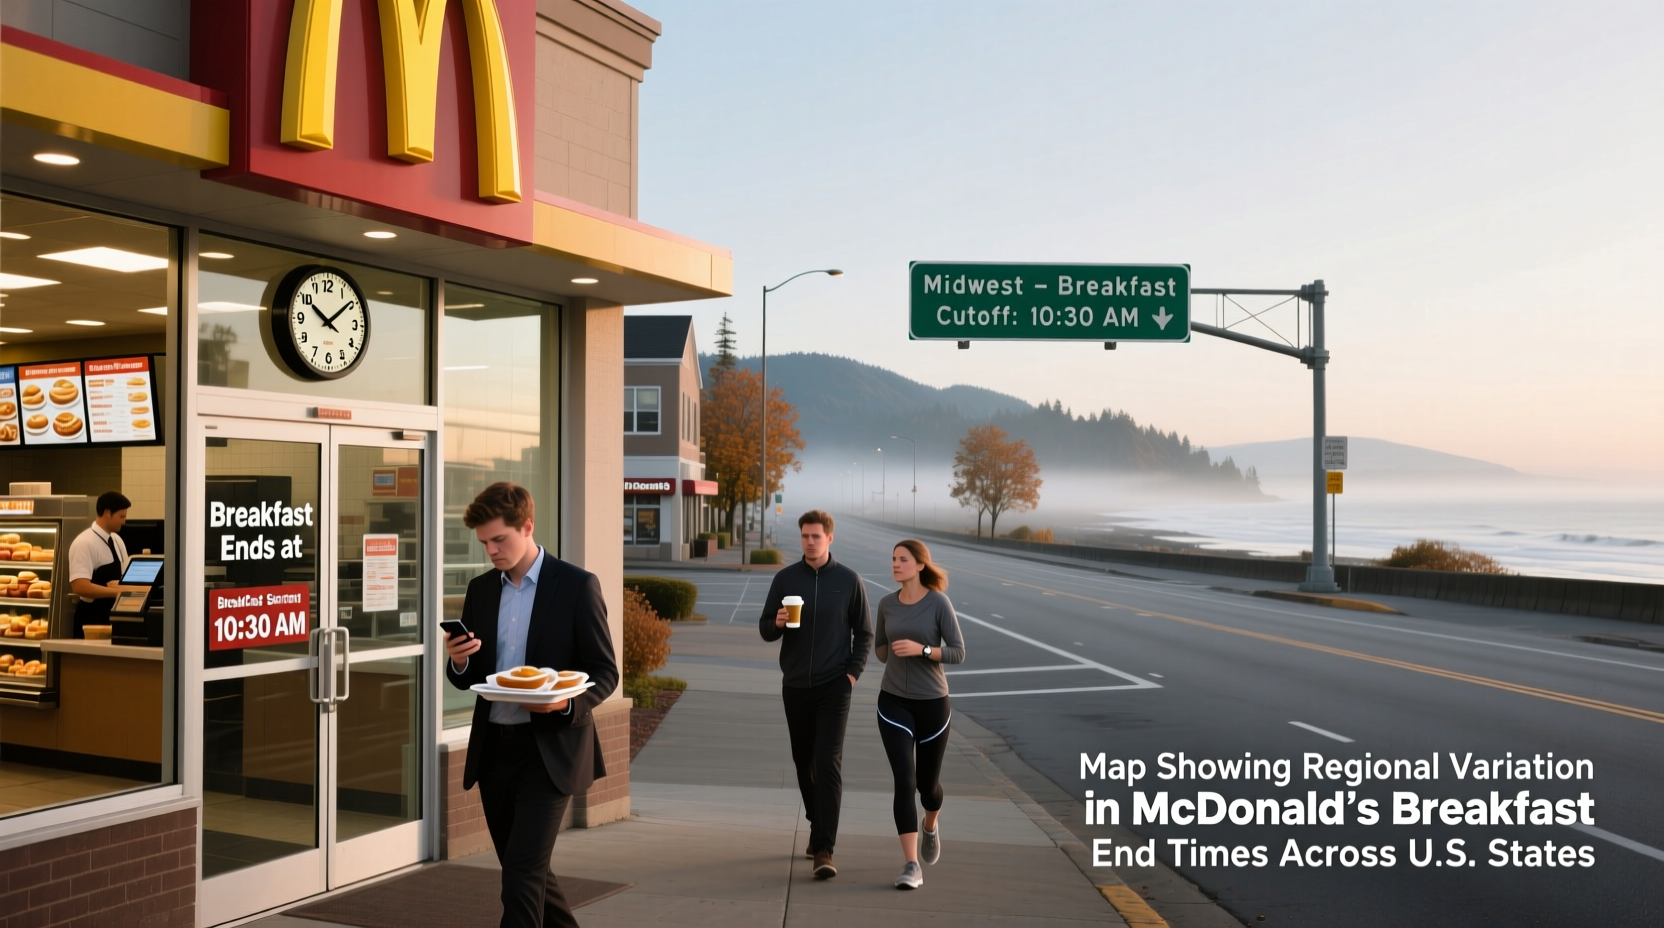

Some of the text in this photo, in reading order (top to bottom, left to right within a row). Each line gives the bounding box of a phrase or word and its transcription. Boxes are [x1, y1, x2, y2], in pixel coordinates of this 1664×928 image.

[321, 279, 334, 293] 12
[924, 274, 1023, 295] Midwest
[1058, 275, 1176, 297] Breakfast
[296, 311, 305, 324] 9
[937, 305, 1139, 327] Cutoff: 10:30 AM
[312, 345, 319, 358] 7
[325, 352, 333, 364] 6
[210, 500, 314, 528] Breakfast
[221, 534, 303, 562] Ends at
[214, 611, 306, 642] 10:30 AM
